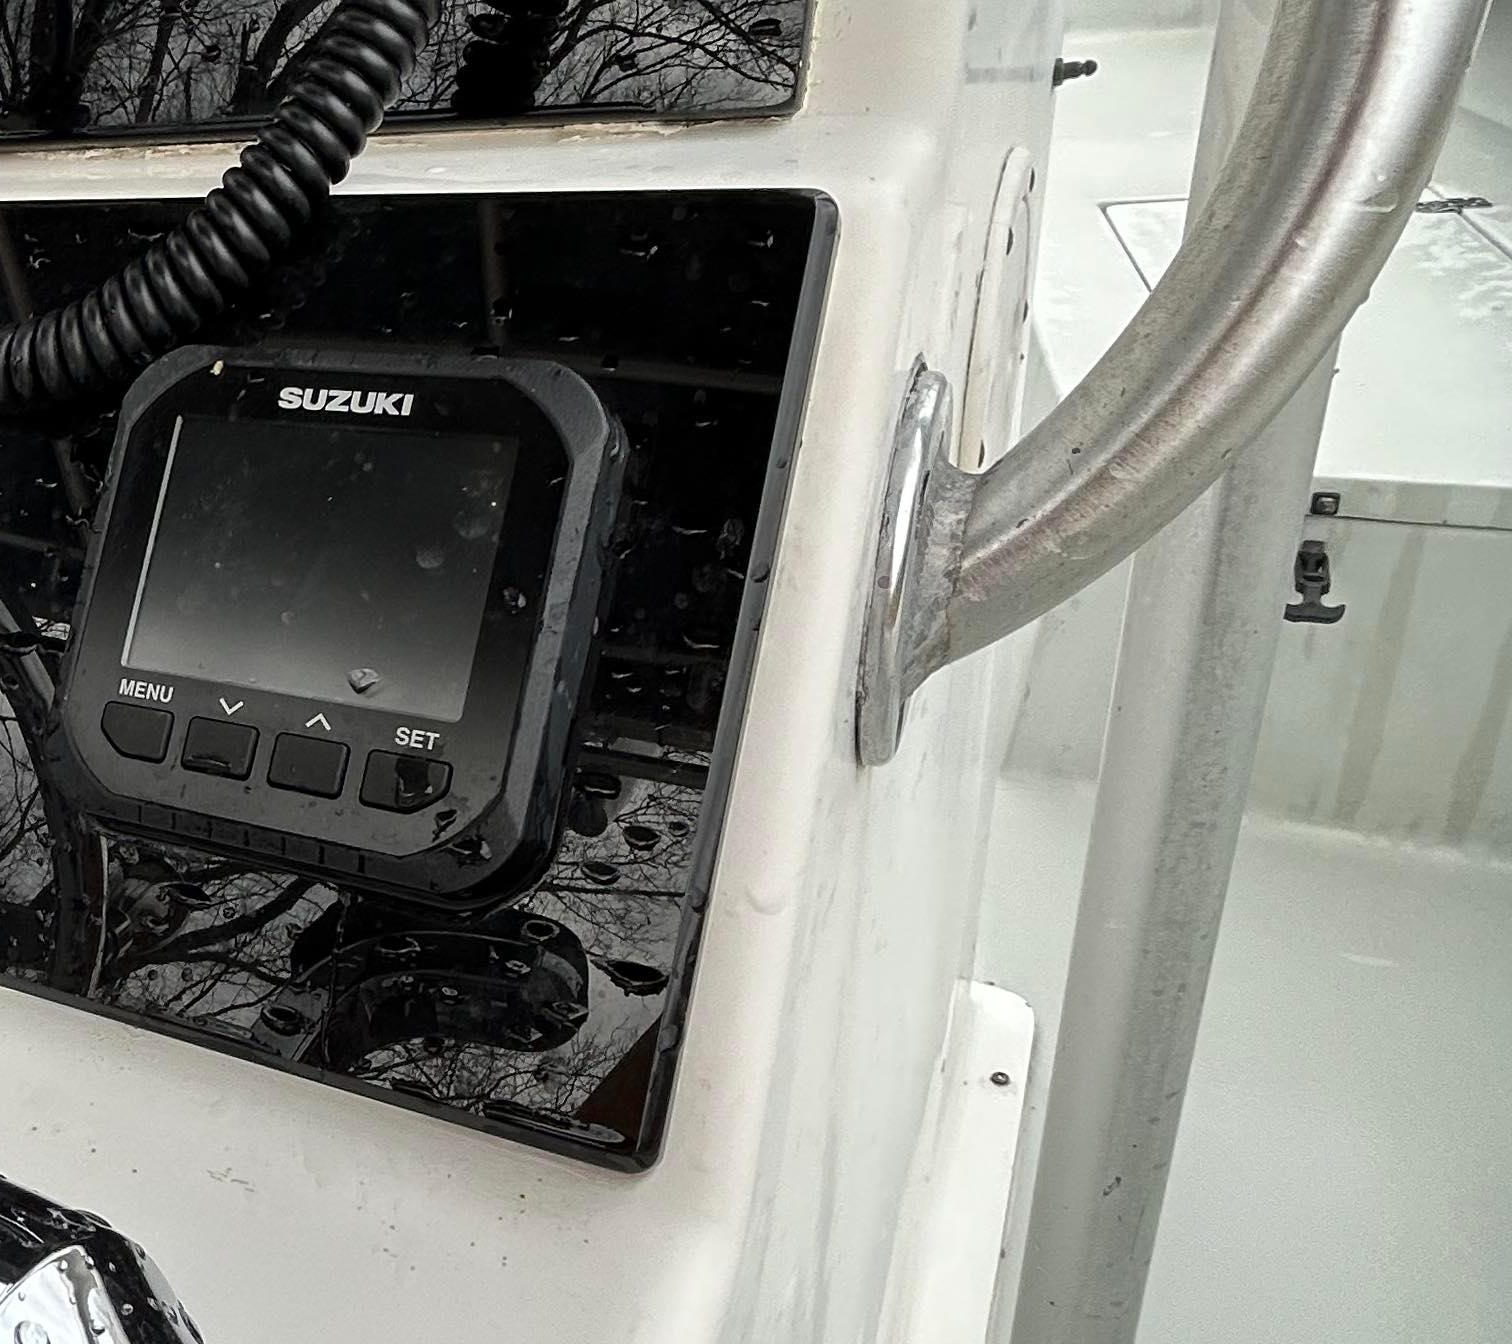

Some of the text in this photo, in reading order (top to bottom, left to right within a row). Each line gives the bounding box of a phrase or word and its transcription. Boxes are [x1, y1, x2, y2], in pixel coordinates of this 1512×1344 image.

[277, 386, 415, 416] SUZUKI
[119, 678, 175, 704] MENU
[394, 726, 441, 751] SET
